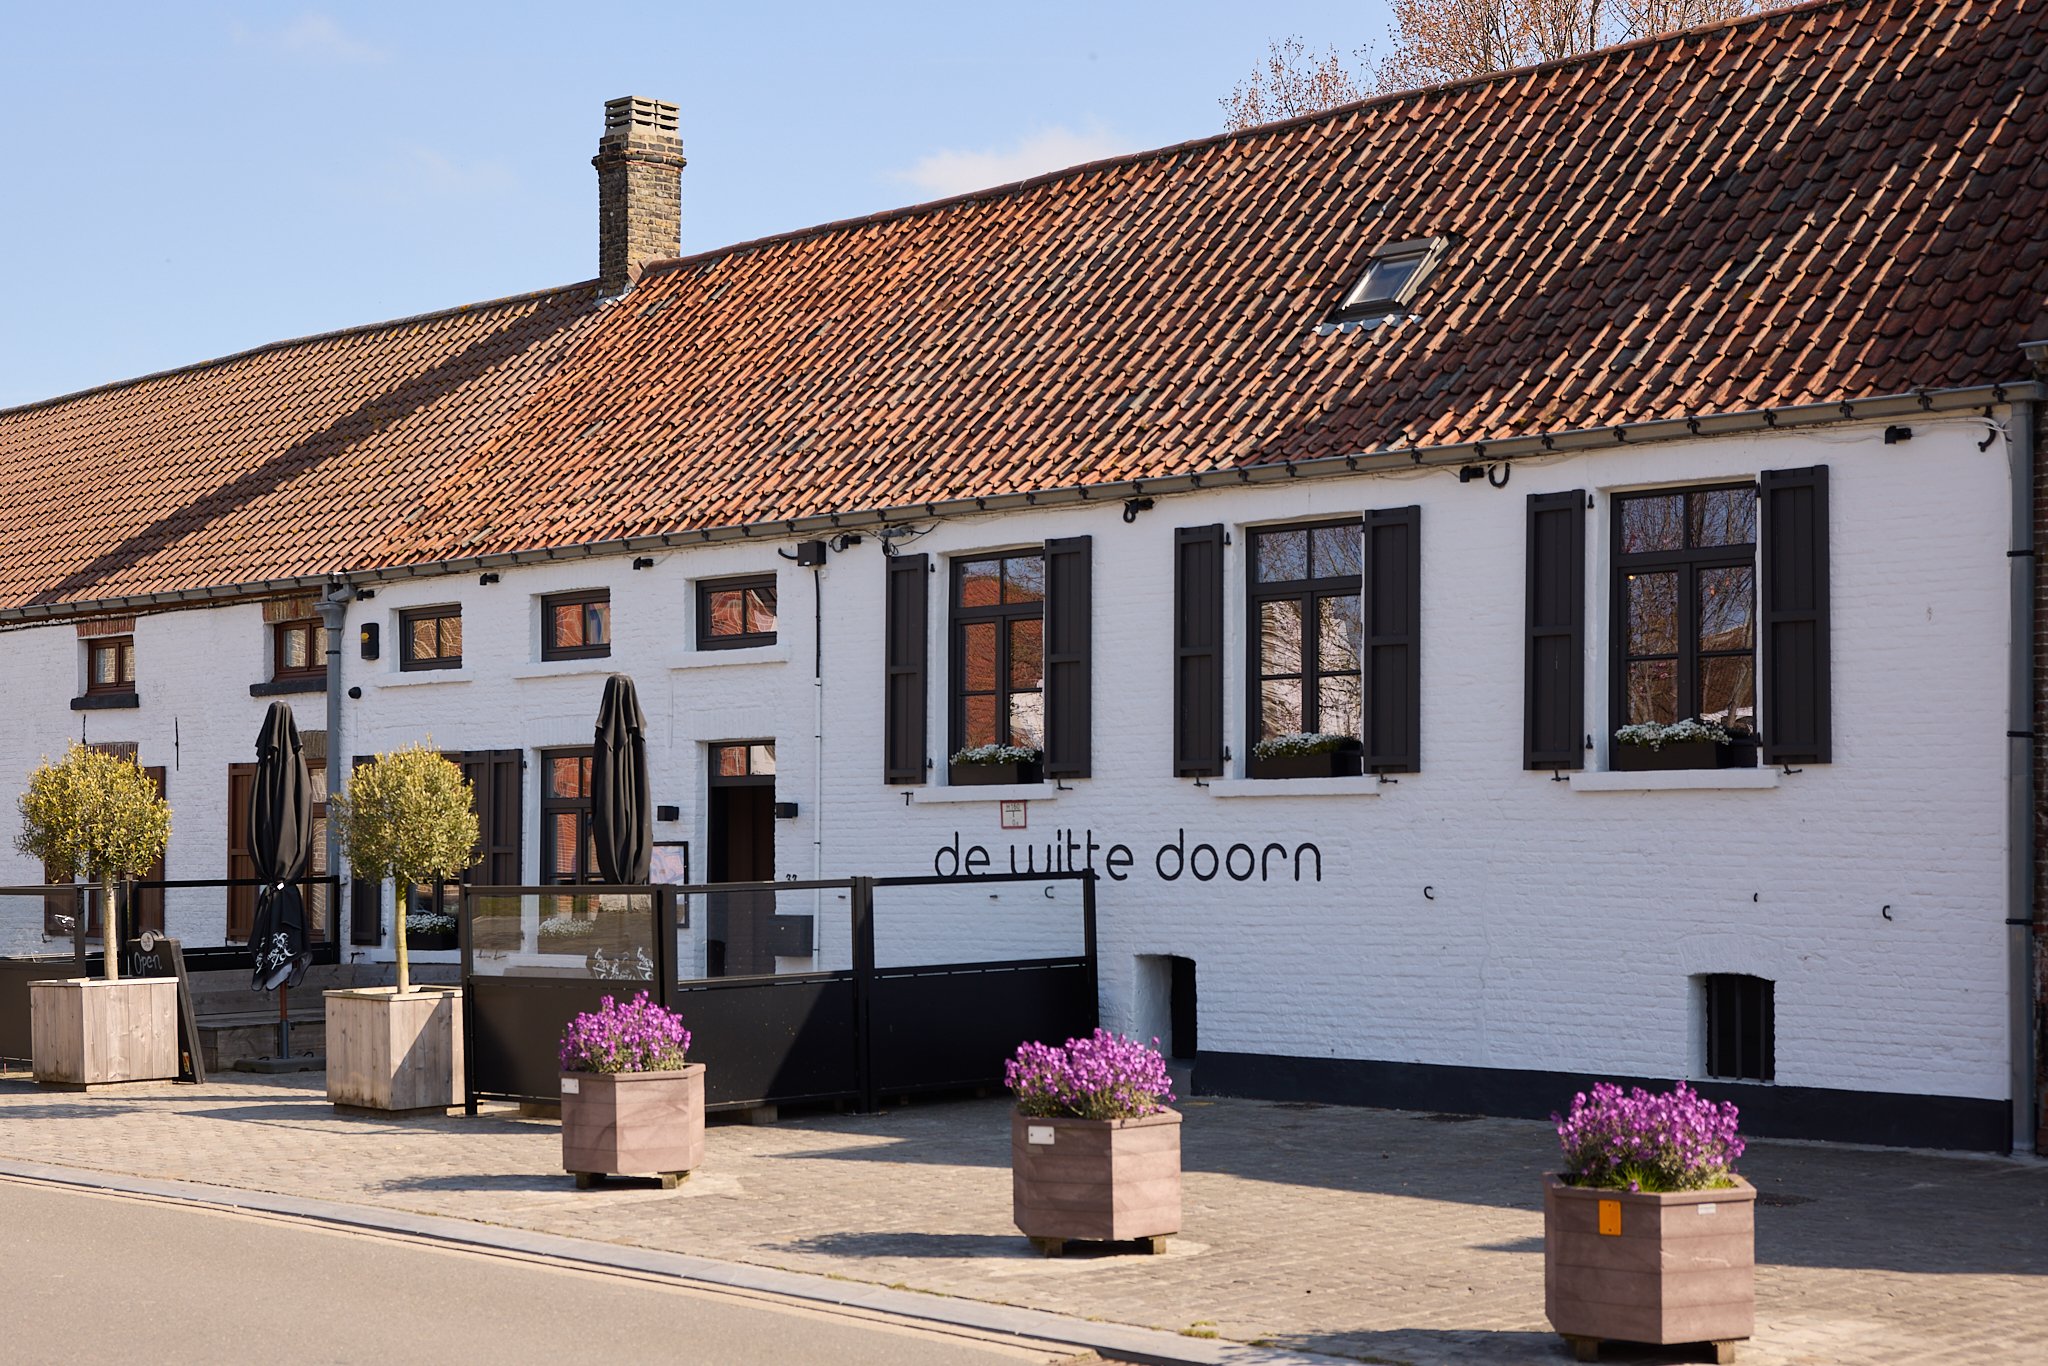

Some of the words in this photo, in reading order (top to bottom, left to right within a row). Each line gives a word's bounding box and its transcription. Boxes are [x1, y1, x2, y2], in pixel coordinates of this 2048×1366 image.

[935, 831, 991, 876] de
[1010, 828, 1134, 881] witte
[1156, 828, 1322, 881] doorn
[134, 951, 162, 976] Open
